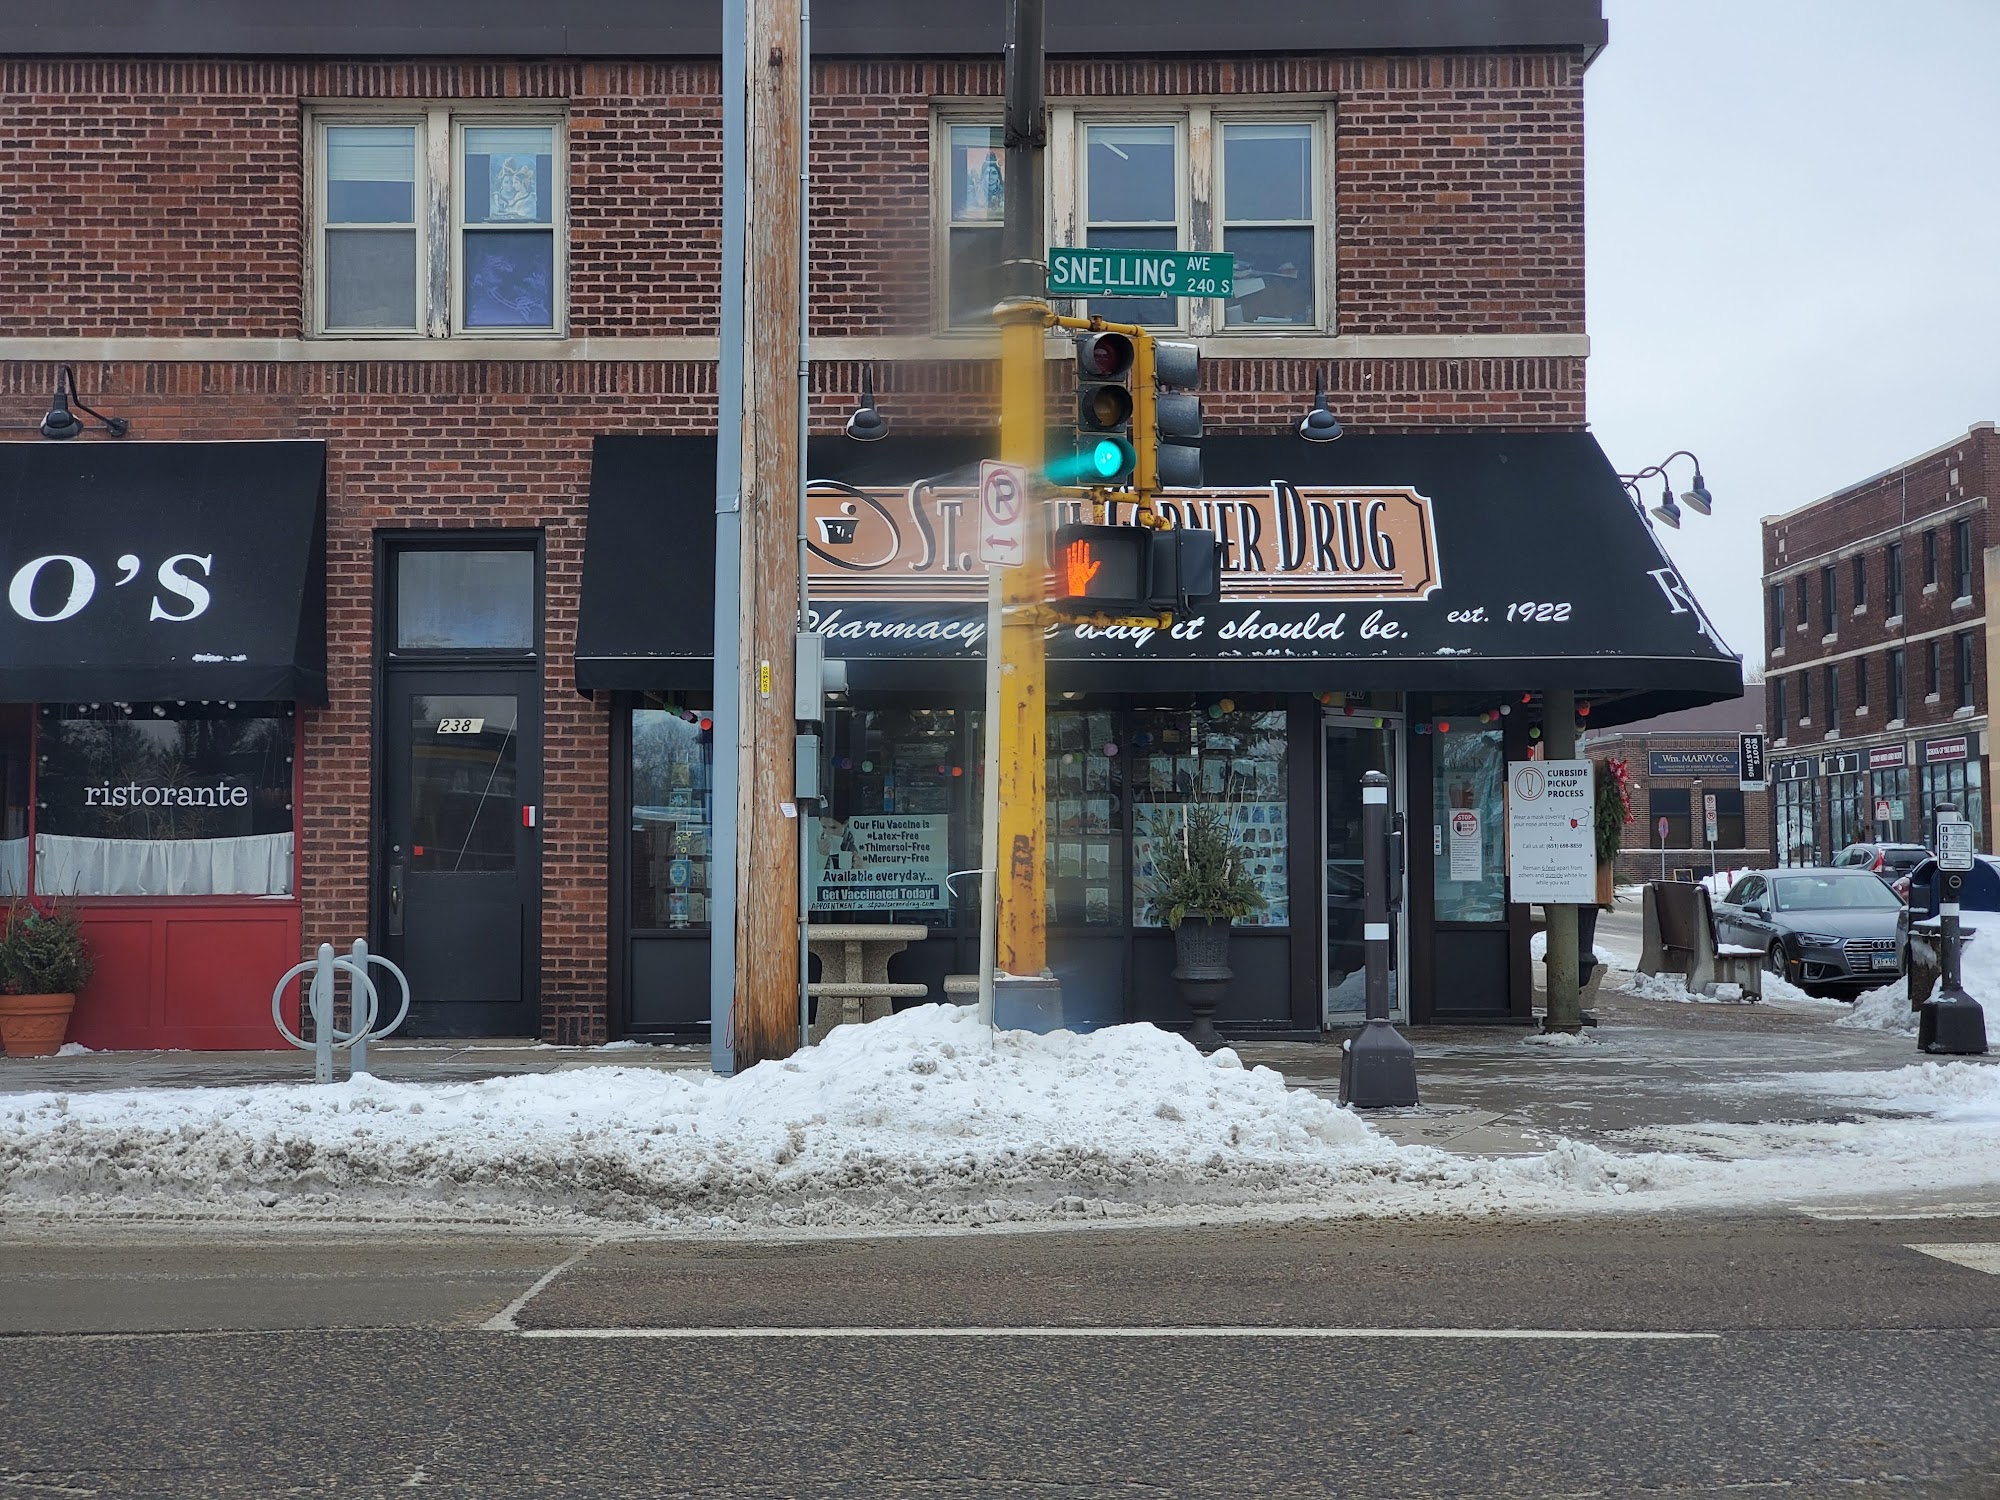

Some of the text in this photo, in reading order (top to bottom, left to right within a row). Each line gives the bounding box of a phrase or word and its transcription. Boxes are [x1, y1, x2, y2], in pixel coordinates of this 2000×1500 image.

[1053, 256, 1211, 287] SNELLING AVE
[1187, 278, 1230, 293] 240 S
[1270, 480, 1397, 572] DRUG
[1447, 601, 1572, 623] est. 1922
[1170, 616, 1205, 640] it
[1218, 610, 1346, 640] should
[1360, 609, 1409, 640] be.
[439, 719, 472, 732] 238
[1662, 754, 1730, 762] Wm. MARVY Co.
[1744, 738, 1755, 778] ROASTING
[1751, 738, 1760, 765] ROOTS
[1547, 769, 1588, 777] CURBSIDE
[84, 780, 248, 807] ristorante
[1547, 790, 1584, 798] PROCESS
[853, 819, 930, 830] Our Flu Vaccine is
[823, 871, 873, 882] Available
[822, 888, 935, 900] Get Vaccinated Today!
